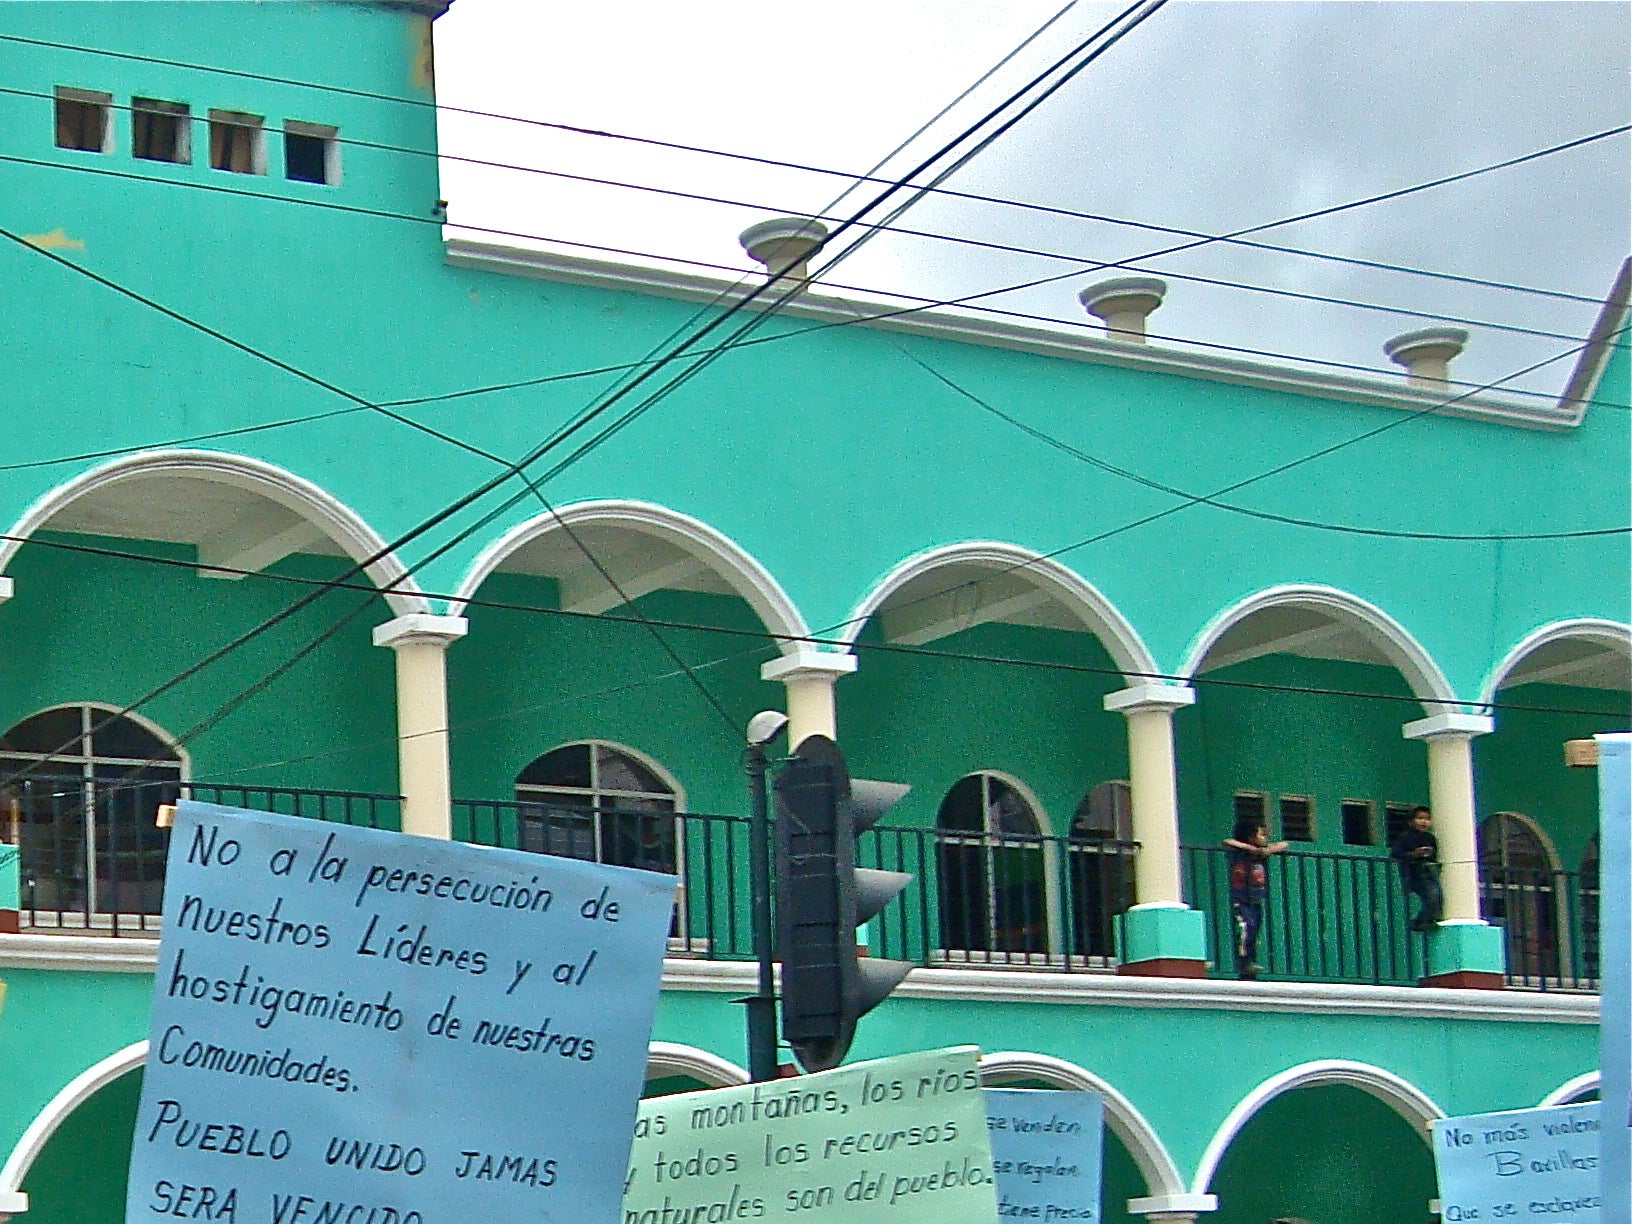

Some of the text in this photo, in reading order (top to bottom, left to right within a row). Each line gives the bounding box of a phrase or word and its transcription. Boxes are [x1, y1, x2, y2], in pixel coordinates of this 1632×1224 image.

[187, 823, 621, 923] No a la persecución de
[176, 895, 598, 995] nuestros Líderes y al
[168, 948, 596, 1063] hostigamiento de nuestras
[158, 1024, 359, 1093] Comunidades.
[633, 1113, 666, 1139] as
[690, 1086, 849, 1130] montañas,
[862, 1072, 904, 1105] los
[1445, 1128, 1473, 1147] No
[1483, 1123, 1529, 1144] más
[147, 1100, 558, 1188] PUEBLO UNIDO JAMAS
[654, 1148, 739, 1182] todos
[764, 1134, 807, 1168] los
[824, 1121, 959, 1160] recursos
[149, 1181, 239, 1224] SERA
[786, 1183, 833, 1212] son
[845, 1172, 880, 1202] del
[890, 1157, 993, 1205] pueblo.
[1492, 1203, 1518, 1217] se
